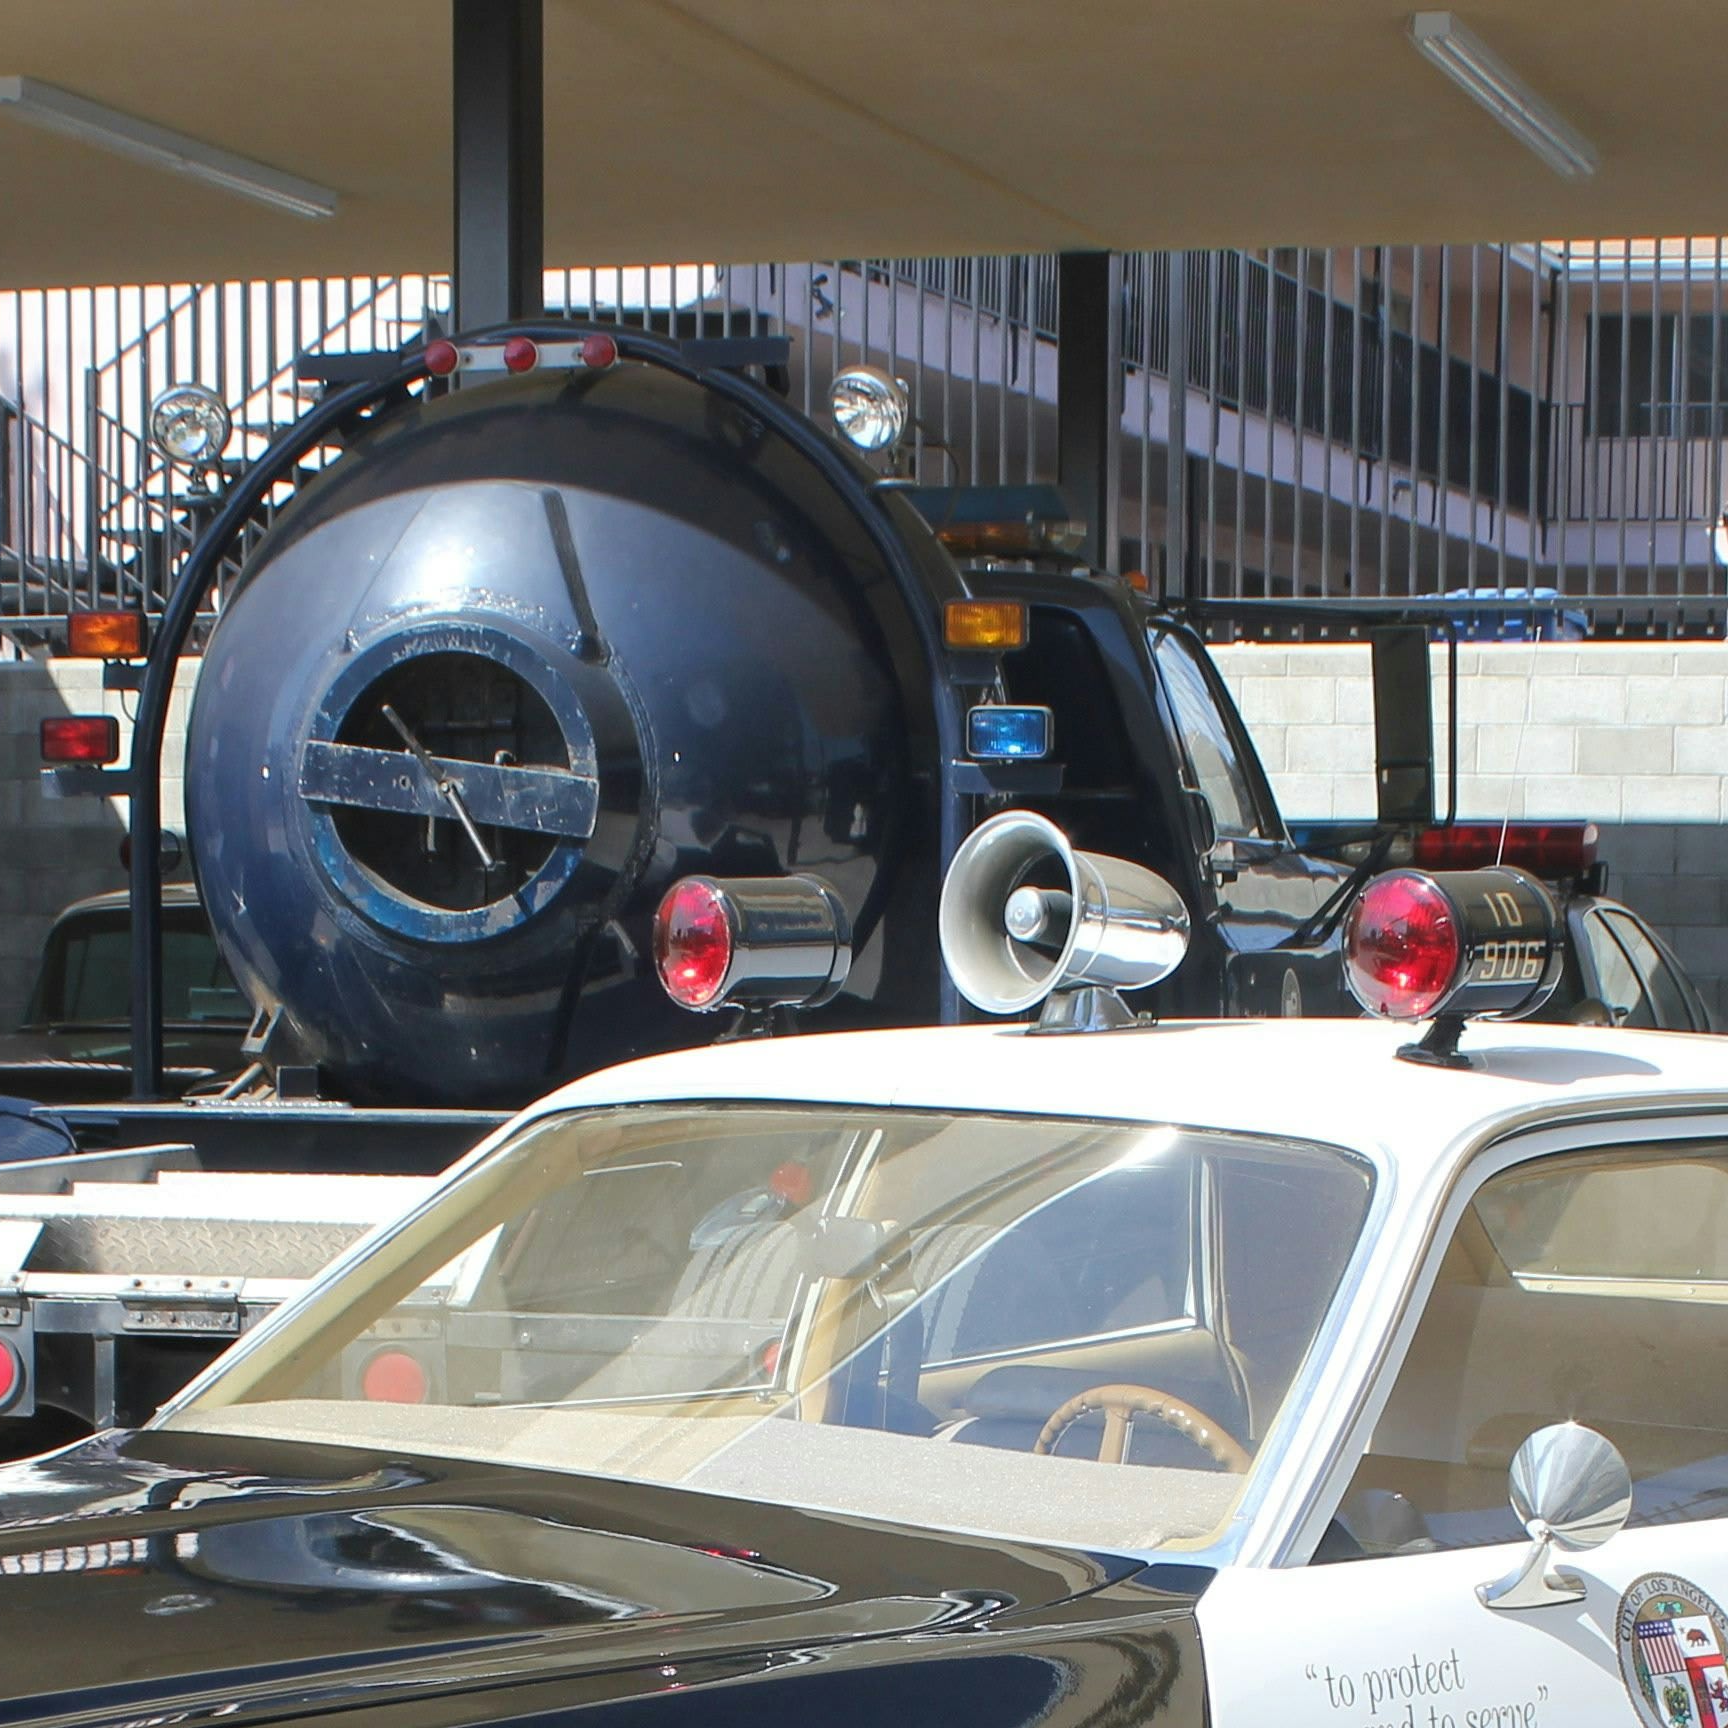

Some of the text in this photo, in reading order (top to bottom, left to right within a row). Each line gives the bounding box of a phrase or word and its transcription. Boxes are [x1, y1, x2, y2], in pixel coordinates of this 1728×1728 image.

[1483, 891, 1522, 927] 10
[1479, 940, 1540, 979] 906
[1622, 1578, 1727, 1642] CITY OF LOS ANGELES
[1363, 1648, 1466, 1715] protect
